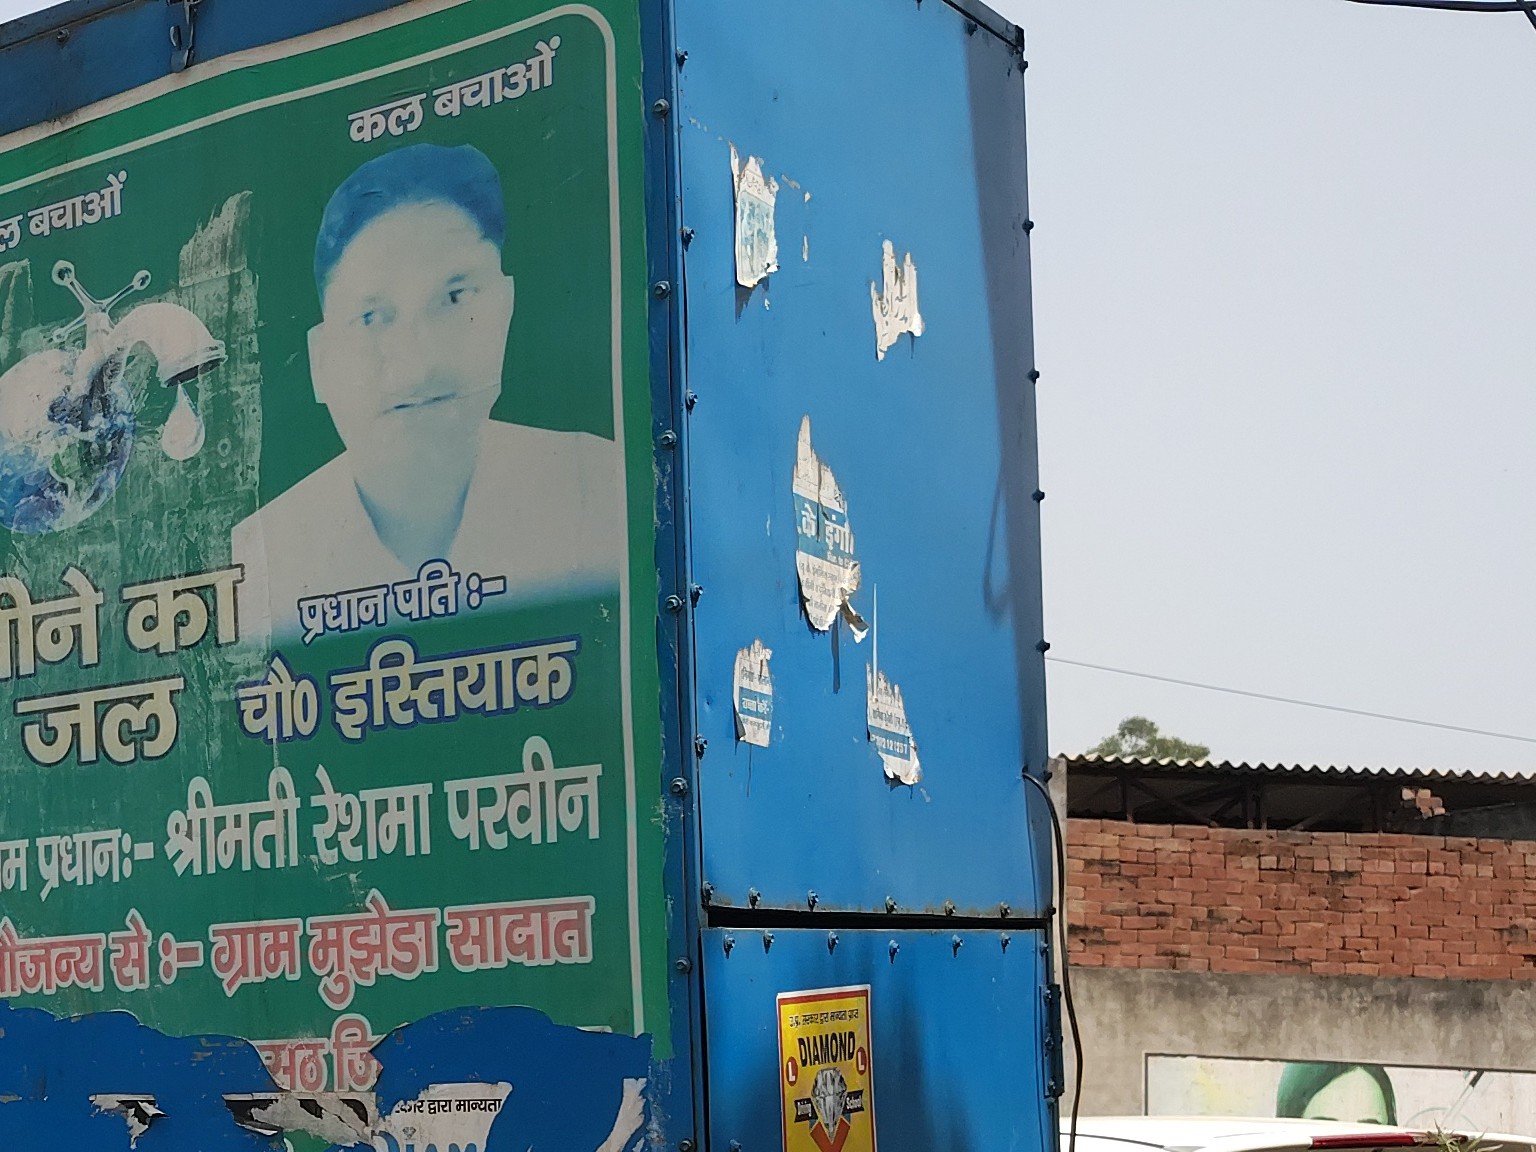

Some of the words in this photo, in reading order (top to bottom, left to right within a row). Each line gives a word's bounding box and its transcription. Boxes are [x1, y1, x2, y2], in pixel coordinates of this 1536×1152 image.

[348, 93, 428, 143] कल
[433, 36, 561, 118] बचाओं
[28, 170, 127, 237] बचाओं
[122, 563, 245, 656] का
[298, 585, 388, 644] प्रधान
[393, 559, 460, 621] पति
[15, 677, 184, 766] जल
[330, 637, 579, 740] इस्तियाक
[165, 766, 300, 877] श्रीमती
[310, 764, 433, 865] रेशमा
[444, 736, 602, 850] परवीन
[209, 918, 303, 998] ग्राम
[444, 894, 595, 972] सादात
[797, 1031, 856, 1067] DIAMOND
[428, 1099, 452, 1114] द्वारा
